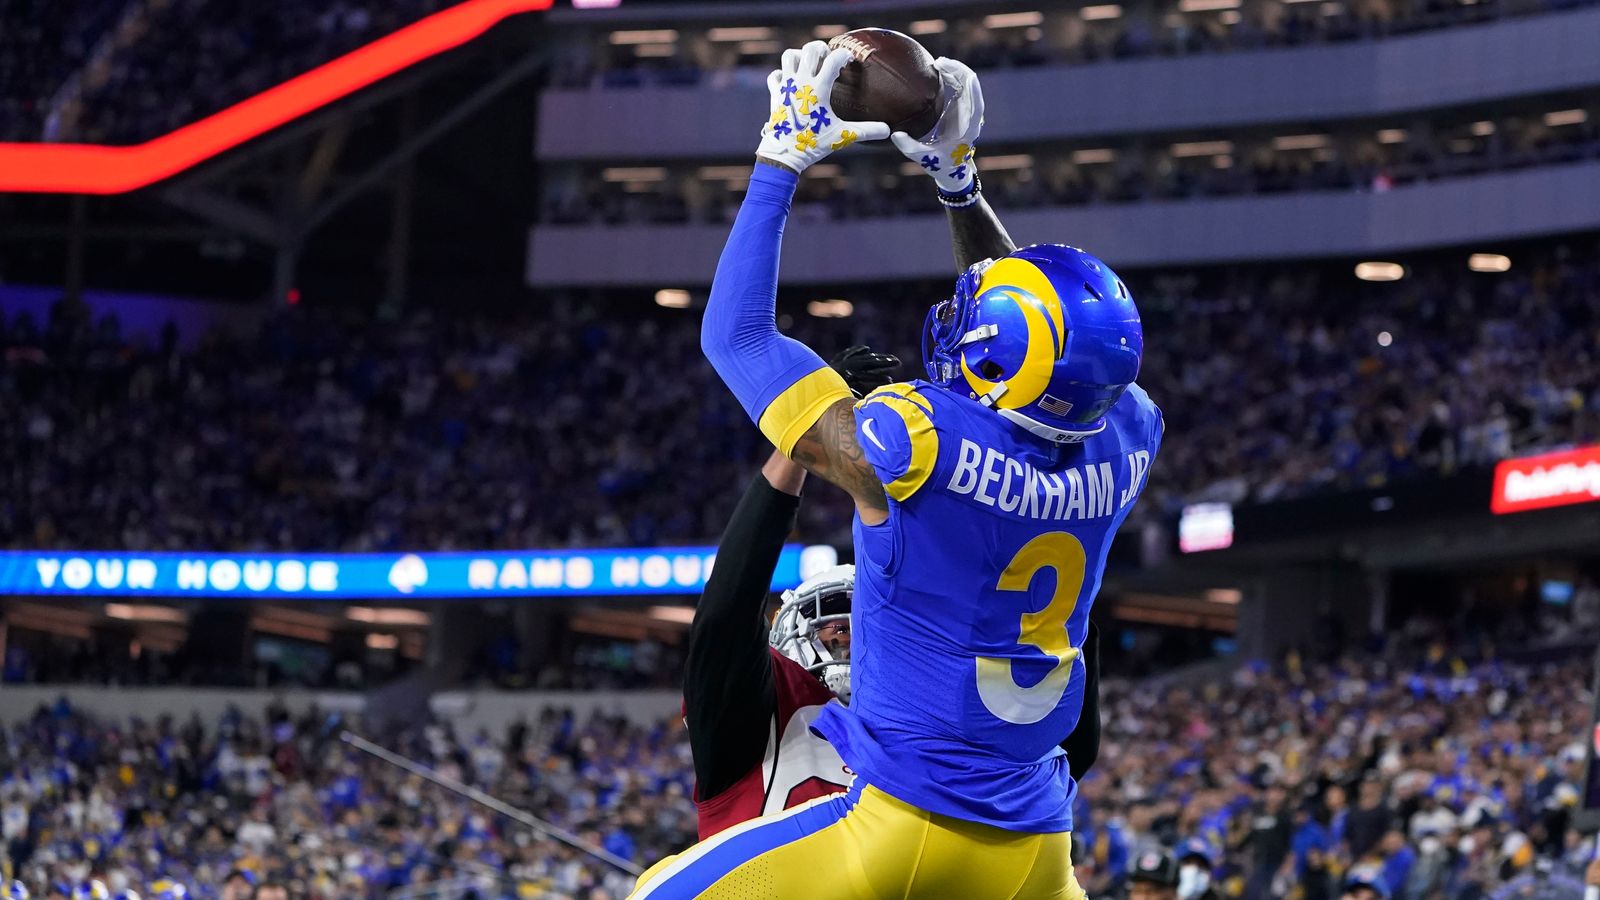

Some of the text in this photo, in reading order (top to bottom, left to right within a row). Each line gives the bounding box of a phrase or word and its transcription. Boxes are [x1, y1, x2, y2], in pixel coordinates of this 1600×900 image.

[947, 438, 1115, 520] BECKHAM
[37, 559, 338, 591] YOUR HOUSE
[468, 555, 717, 589] RAMS HOU
[976, 531, 1086, 725] 3
